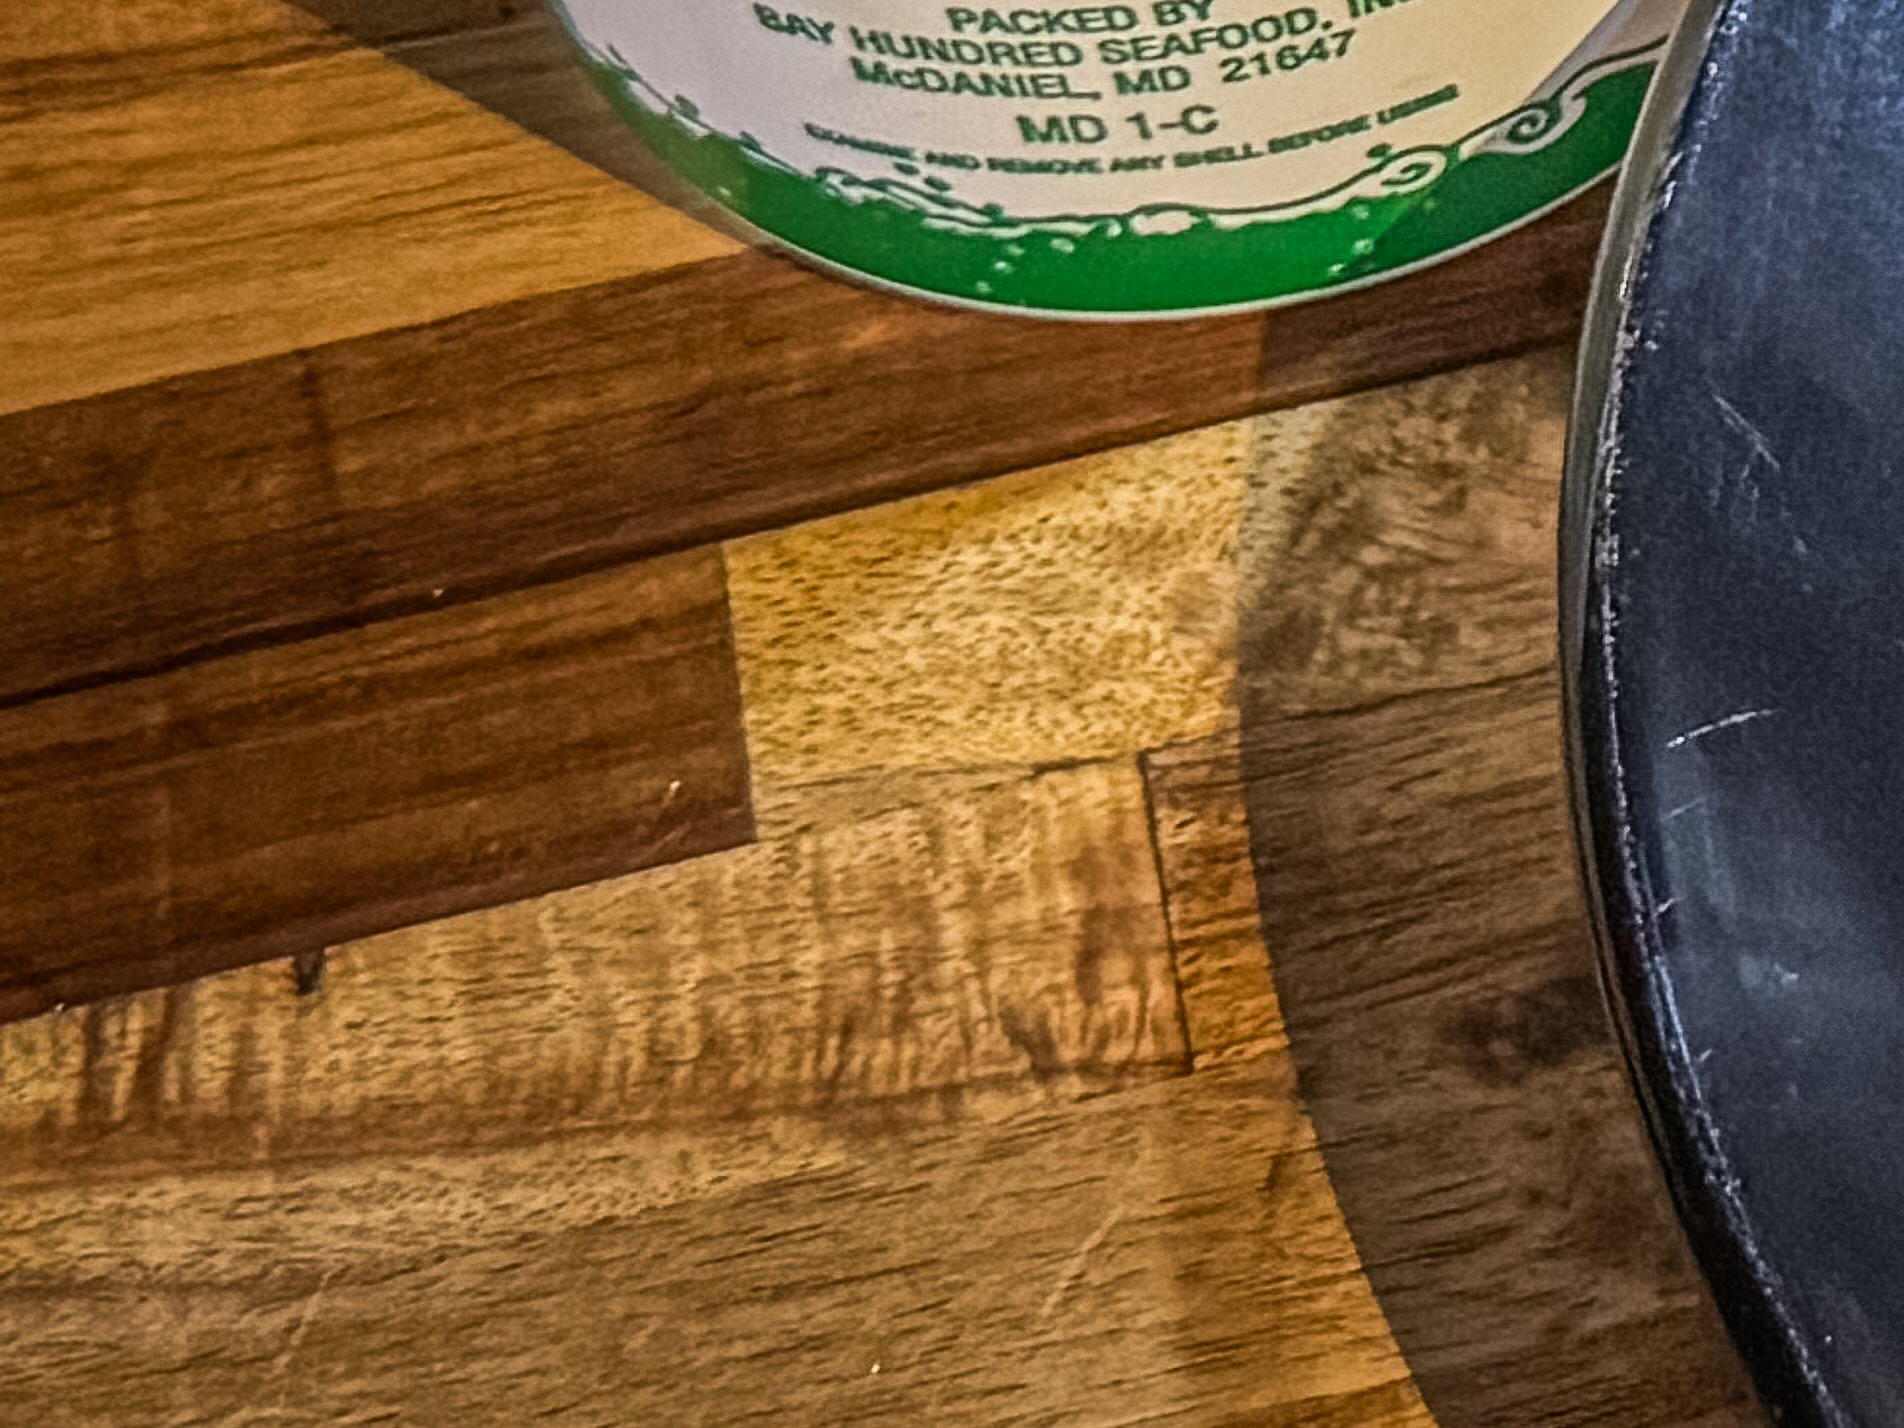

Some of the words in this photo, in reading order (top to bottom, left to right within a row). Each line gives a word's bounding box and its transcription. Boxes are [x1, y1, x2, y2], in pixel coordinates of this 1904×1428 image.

[752, 2, 836, 45] BAY
[849, 25, 1084, 68] HUNDRED
[945, 6, 1139, 36] PACKED
[1112, 65, 1192, 96] MD
[1218, 28, 1357, 84] 21647
[1015, 113, 1108, 144] MD
[1125, 104, 1219, 141] 1-C
